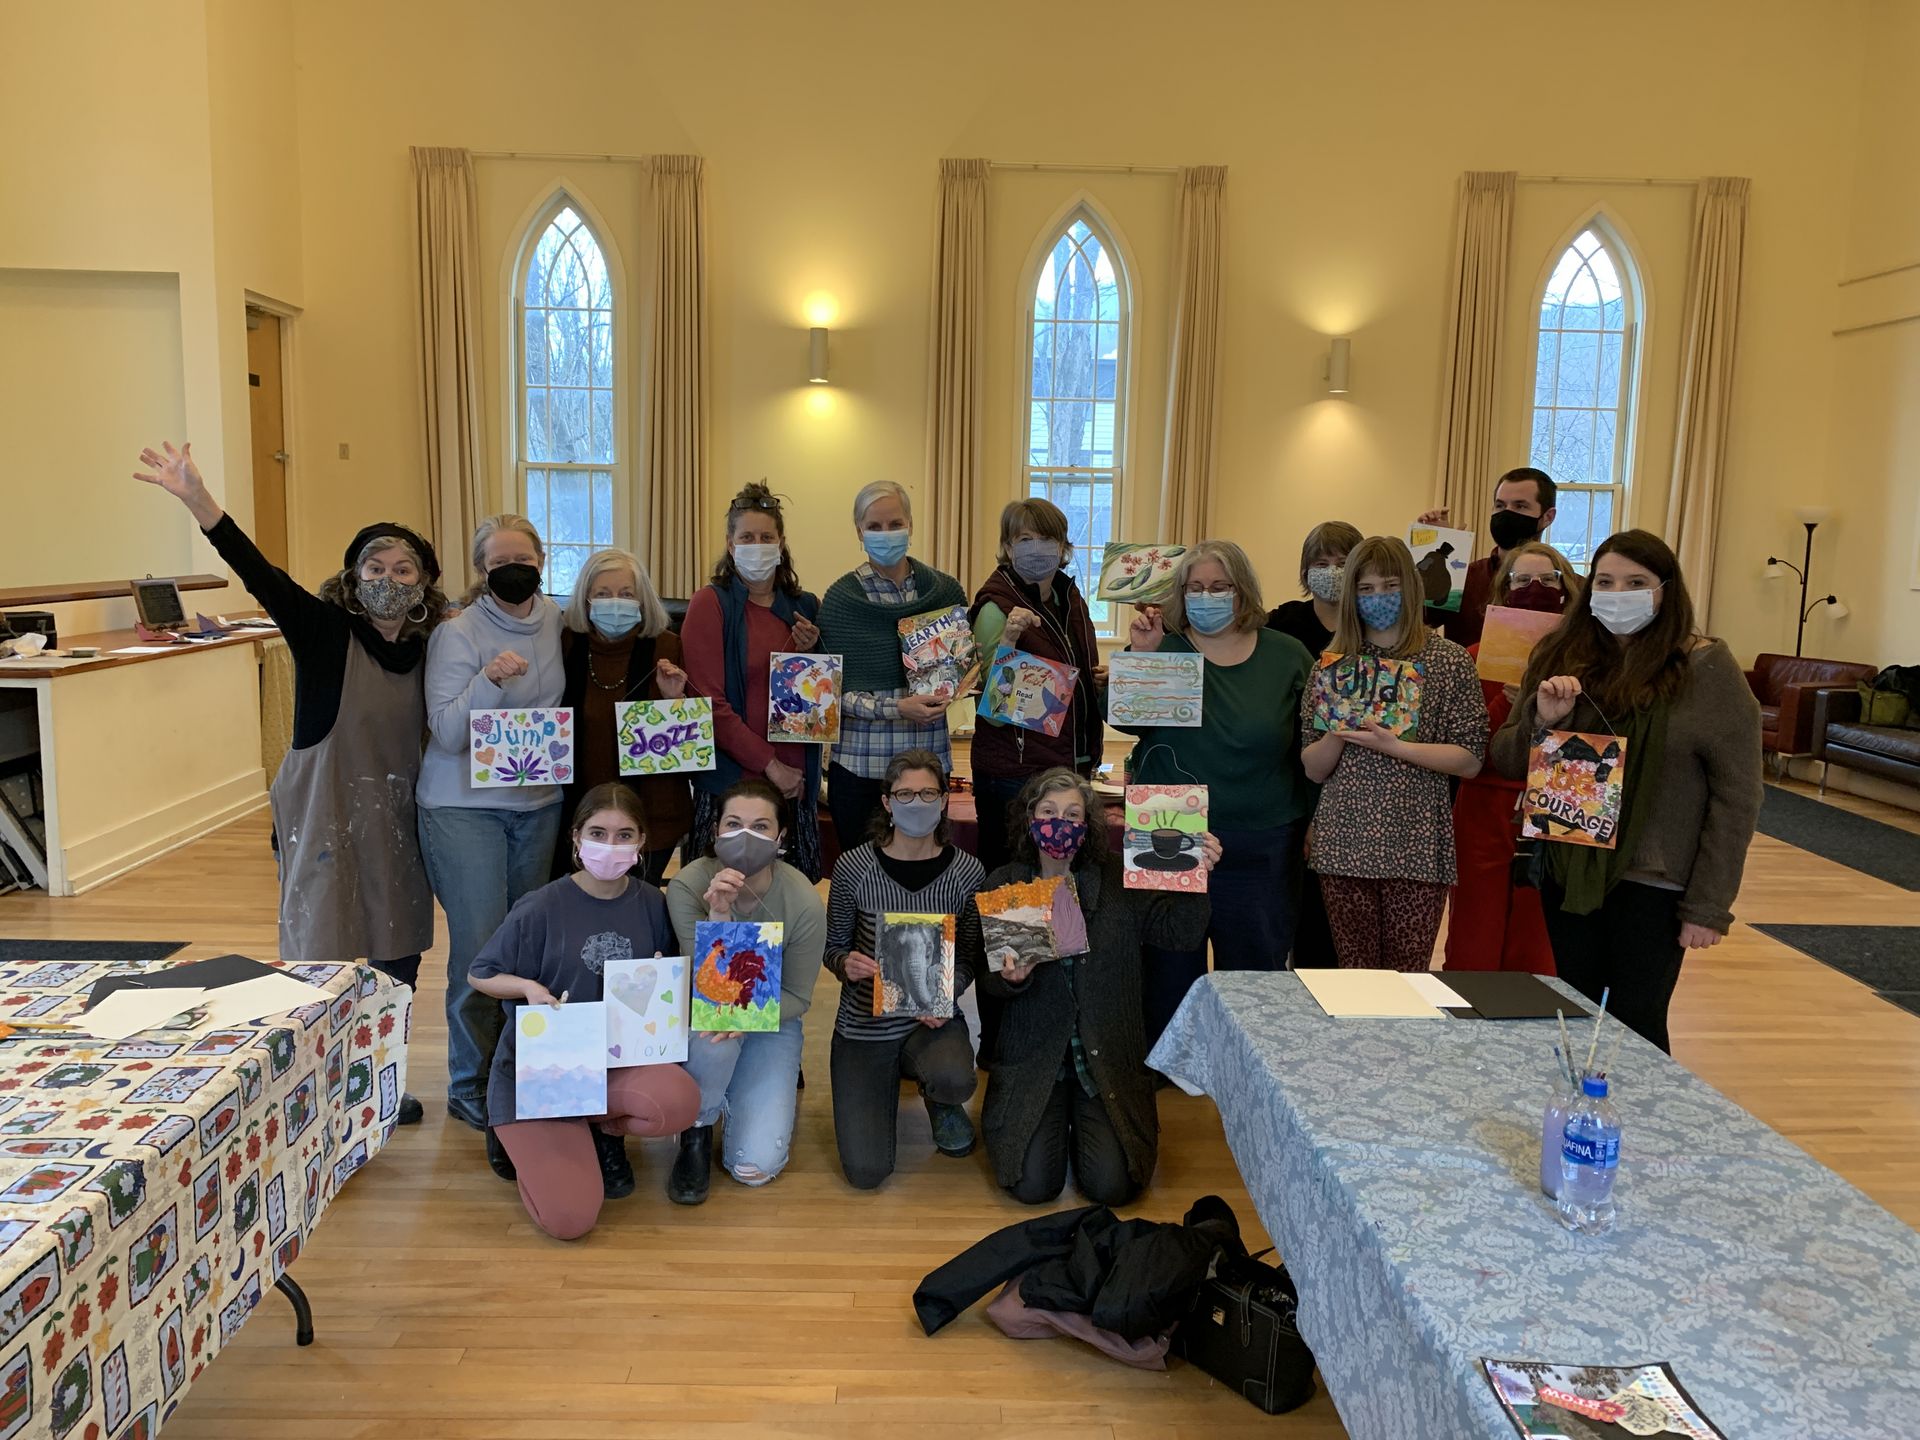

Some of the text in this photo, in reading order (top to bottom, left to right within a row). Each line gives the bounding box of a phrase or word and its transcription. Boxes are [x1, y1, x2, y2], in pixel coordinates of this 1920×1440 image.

[908, 614, 951, 648] EARTH
[1016, 689, 1033, 700] Read
[1525, 788, 1614, 836] COURAGE
[1543, 1387, 1601, 1410] grow
